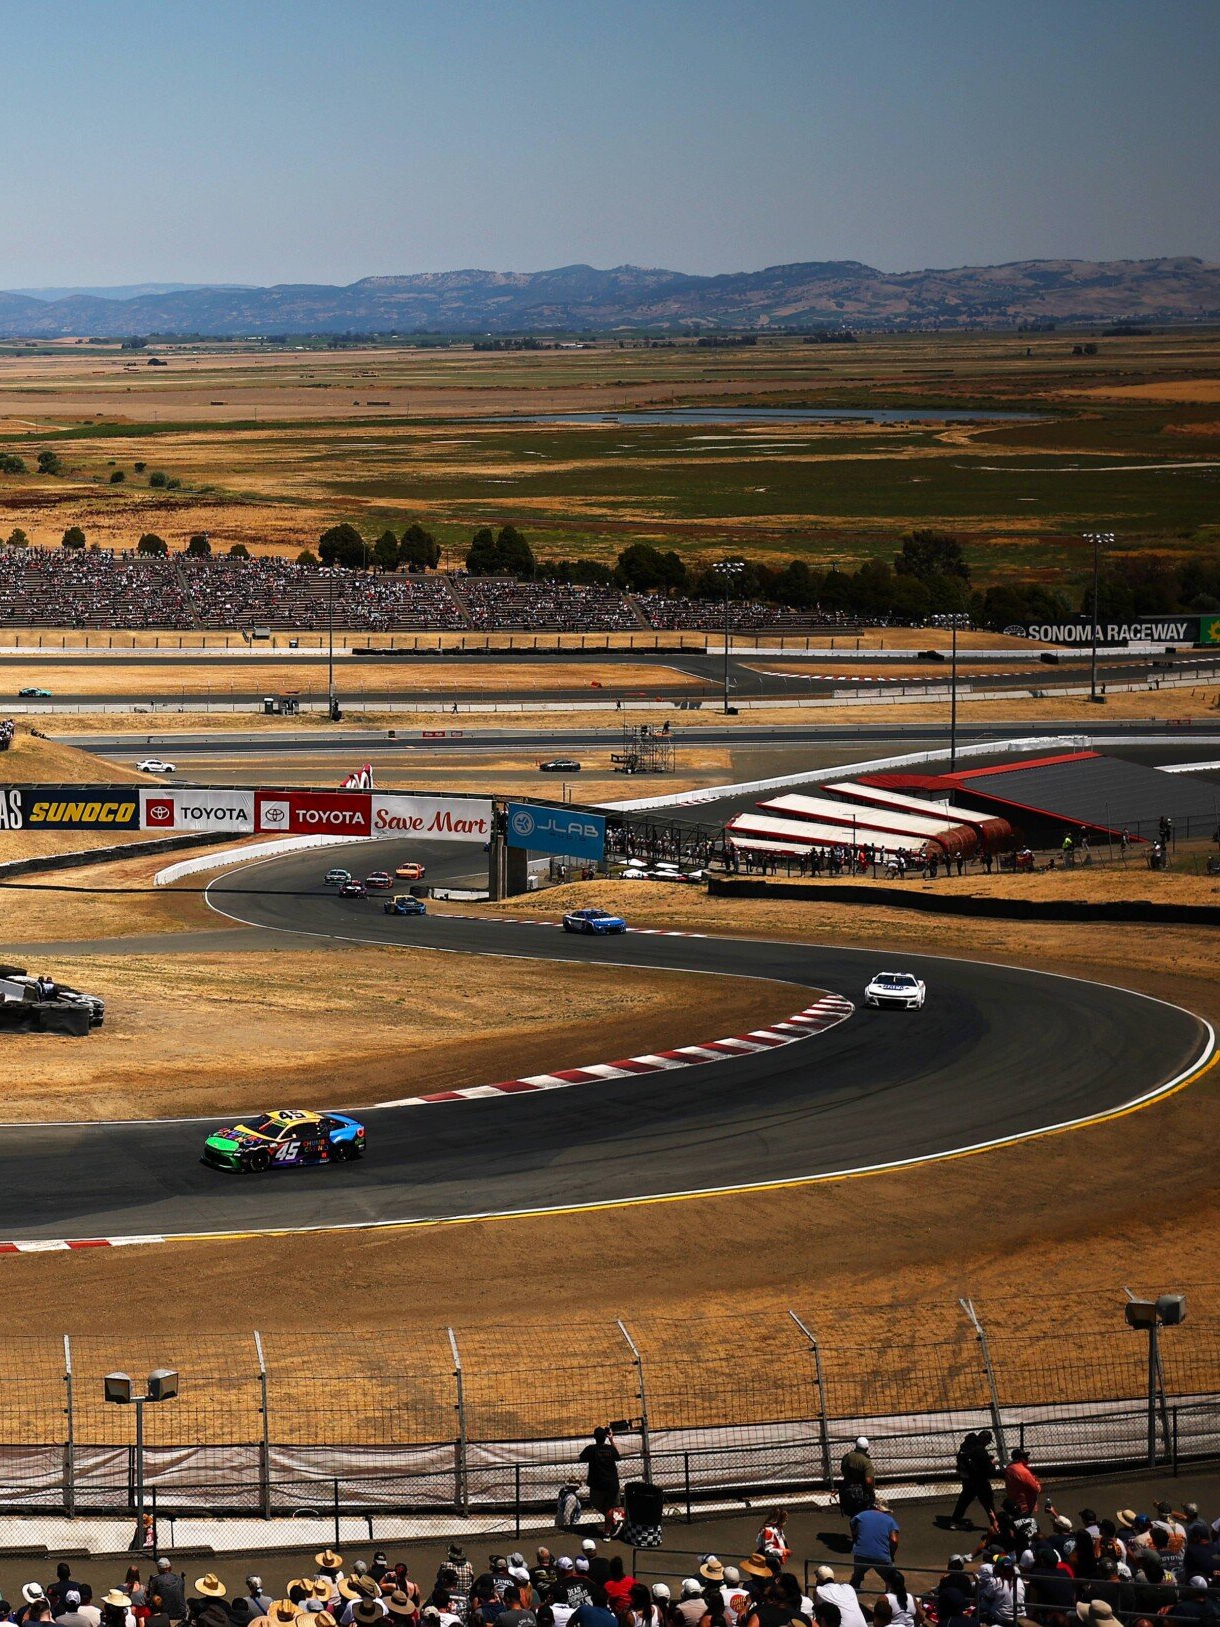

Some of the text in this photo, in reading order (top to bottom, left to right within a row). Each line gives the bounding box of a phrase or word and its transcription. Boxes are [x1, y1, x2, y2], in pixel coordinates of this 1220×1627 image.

[1028, 623, 1188, 642] SONOMA RACEWAY
[29, 802, 136, 822] SUNOCO
[180, 807, 247, 821] TOYOTA
[295, 810, 365, 824] TOYOTA
[374, 808, 488, 834] Save Mart
[537, 819, 599, 838] JLAB
[279, 1109, 307, 1121] 45
[274, 1141, 301, 1161] 45
